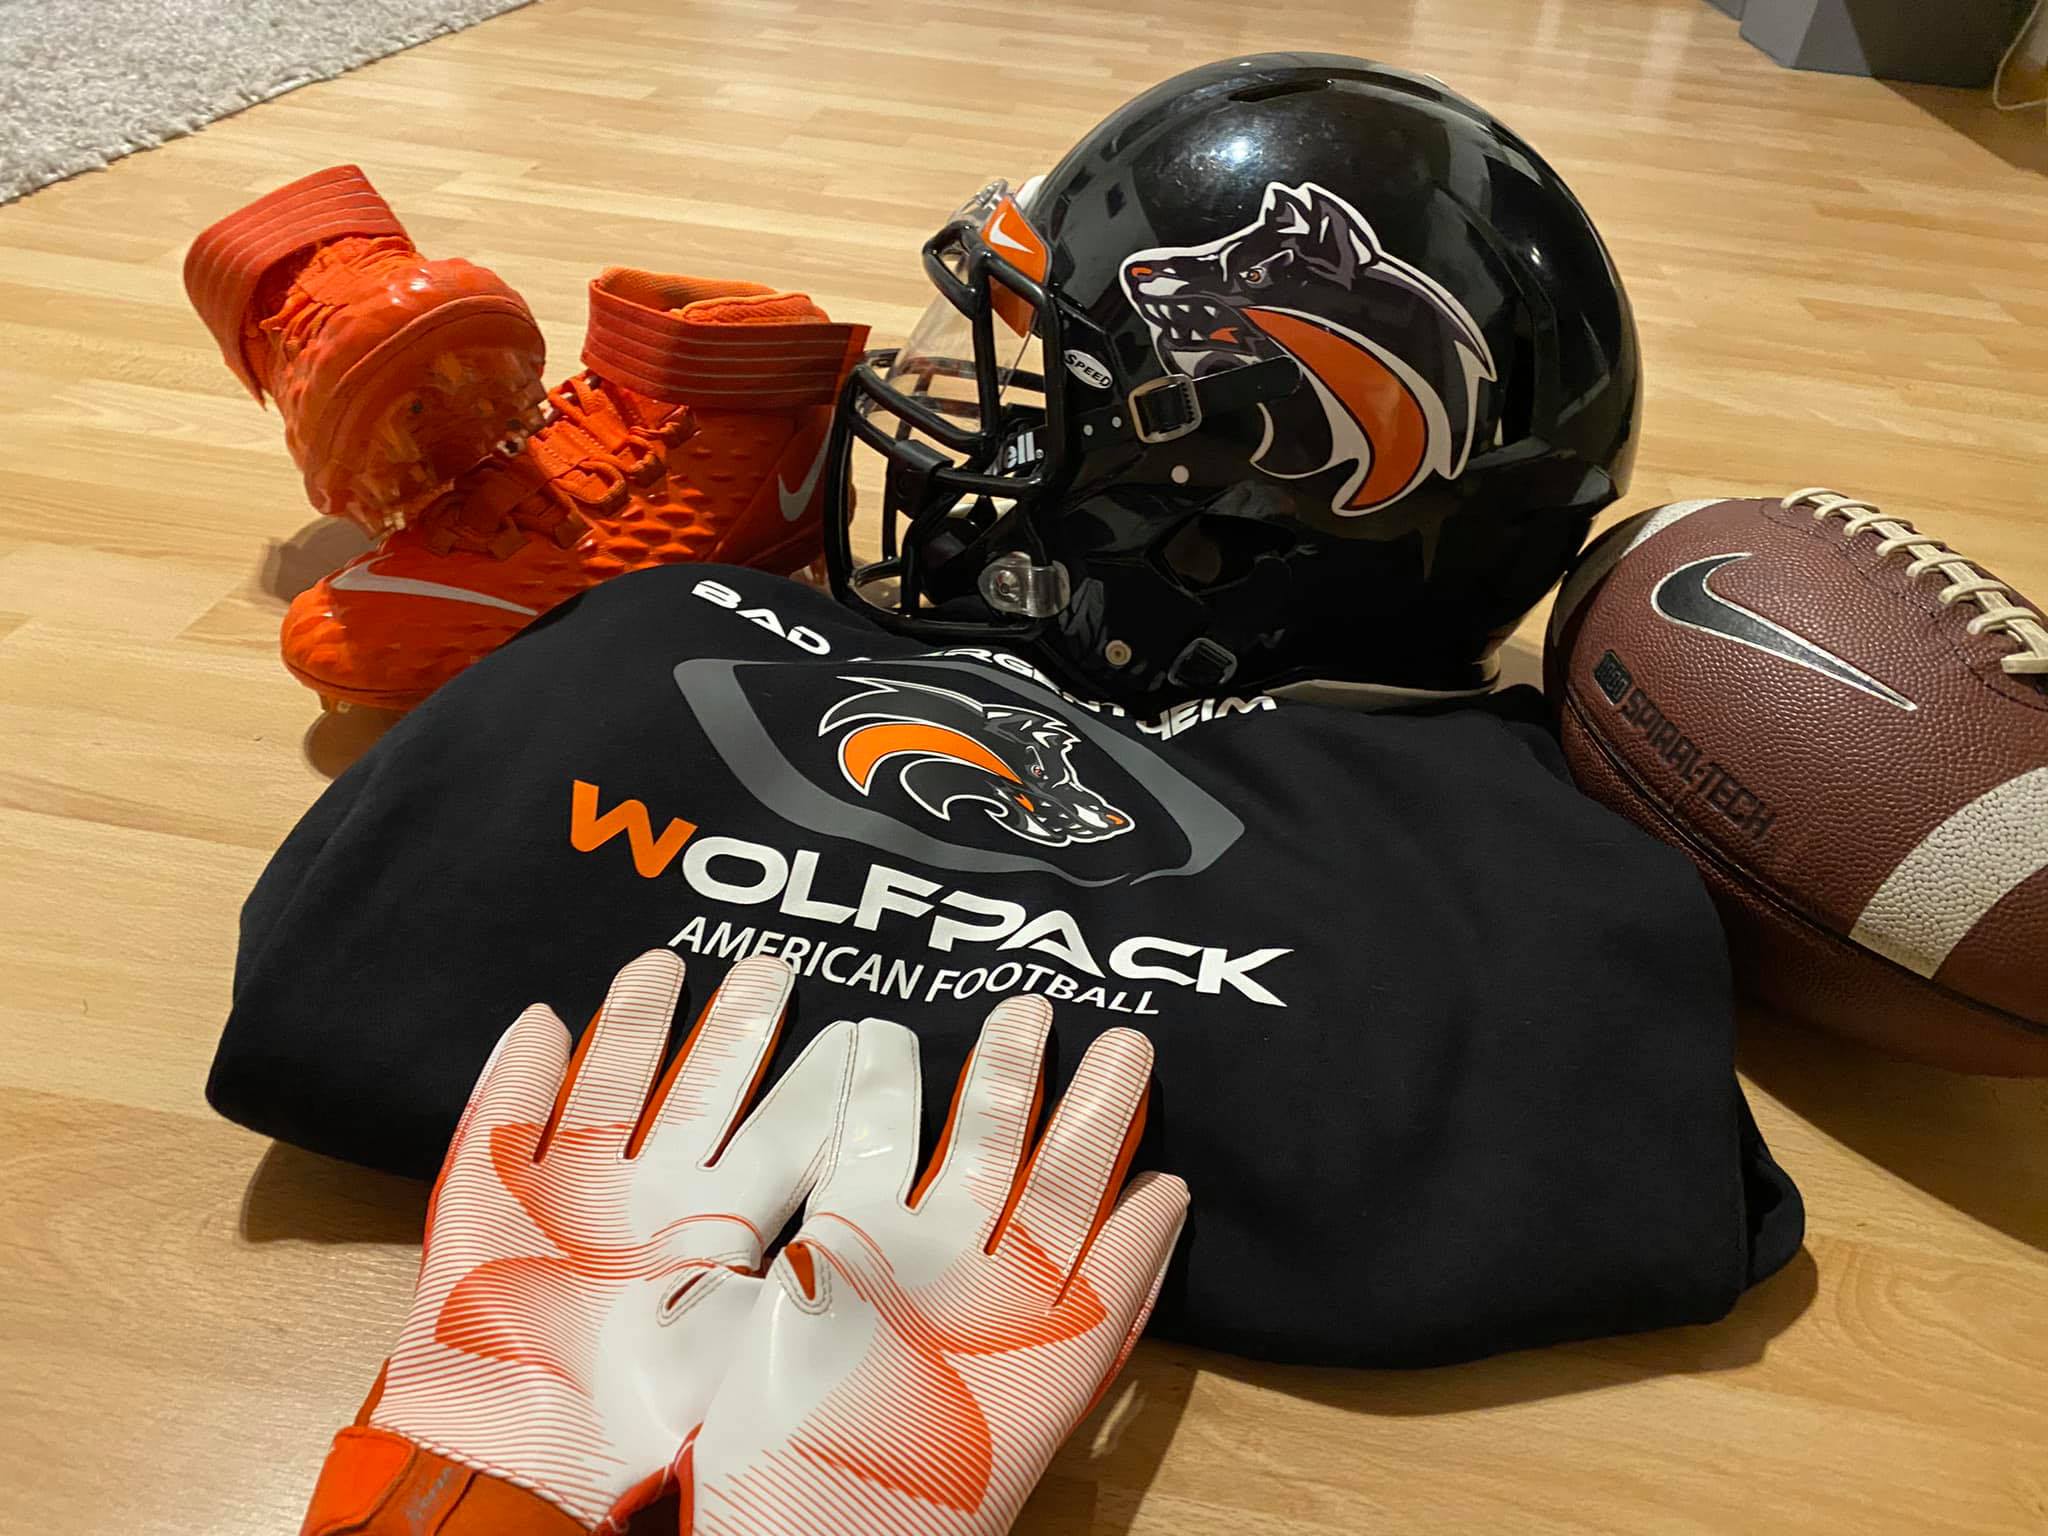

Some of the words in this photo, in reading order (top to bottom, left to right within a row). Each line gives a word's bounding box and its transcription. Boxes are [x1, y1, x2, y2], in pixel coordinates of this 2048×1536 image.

[1064, 353, 1111, 387] SPEED
[691, 579, 831, 656] BAD
[570, 779, 1295, 1008] WOLFPACK
[666, 915, 925, 1001] AMERICAN
[924, 961, 1160, 1016] FOOTBALL
